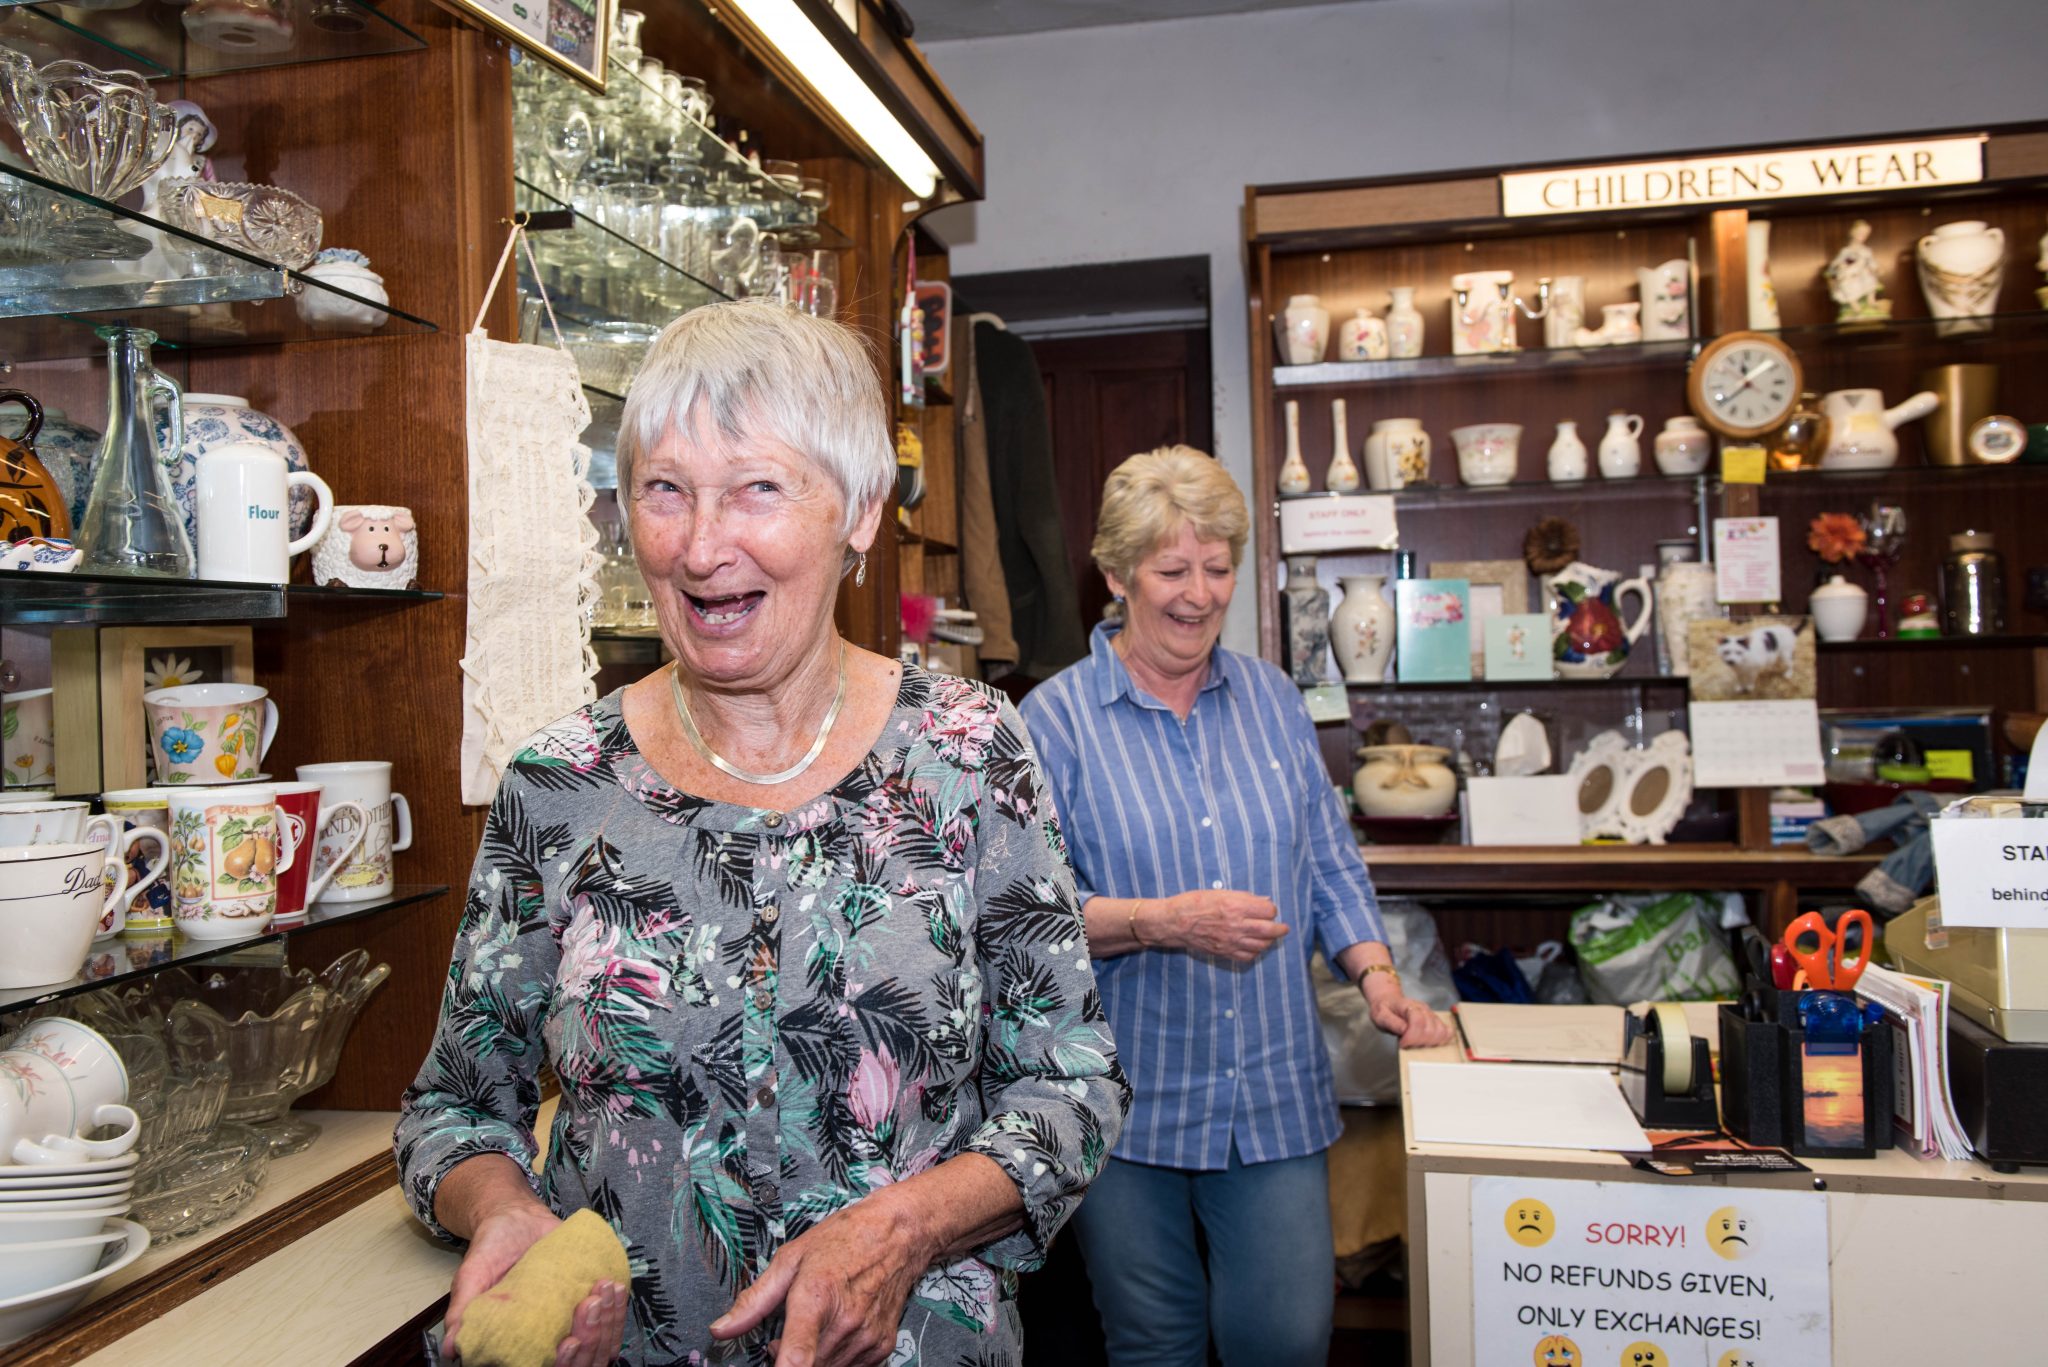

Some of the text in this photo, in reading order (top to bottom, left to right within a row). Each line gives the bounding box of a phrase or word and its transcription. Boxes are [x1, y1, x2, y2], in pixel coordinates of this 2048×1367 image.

[1542, 150, 1940, 209] CHILDRENS WEAR
[248, 504, 280, 520] Flour
[219, 804, 249, 815] PEAR
[2002, 845, 2048, 861] STA
[62, 865, 104, 894] Dad
[1992, 888, 2048, 901] behind
[1585, 1223, 1686, 1249] SORRY!
[1503, 1262, 1775, 1302] NO REFUNDS GIVEN,
[1517, 1305, 1763, 1341] ONLY EXCHANGES!
